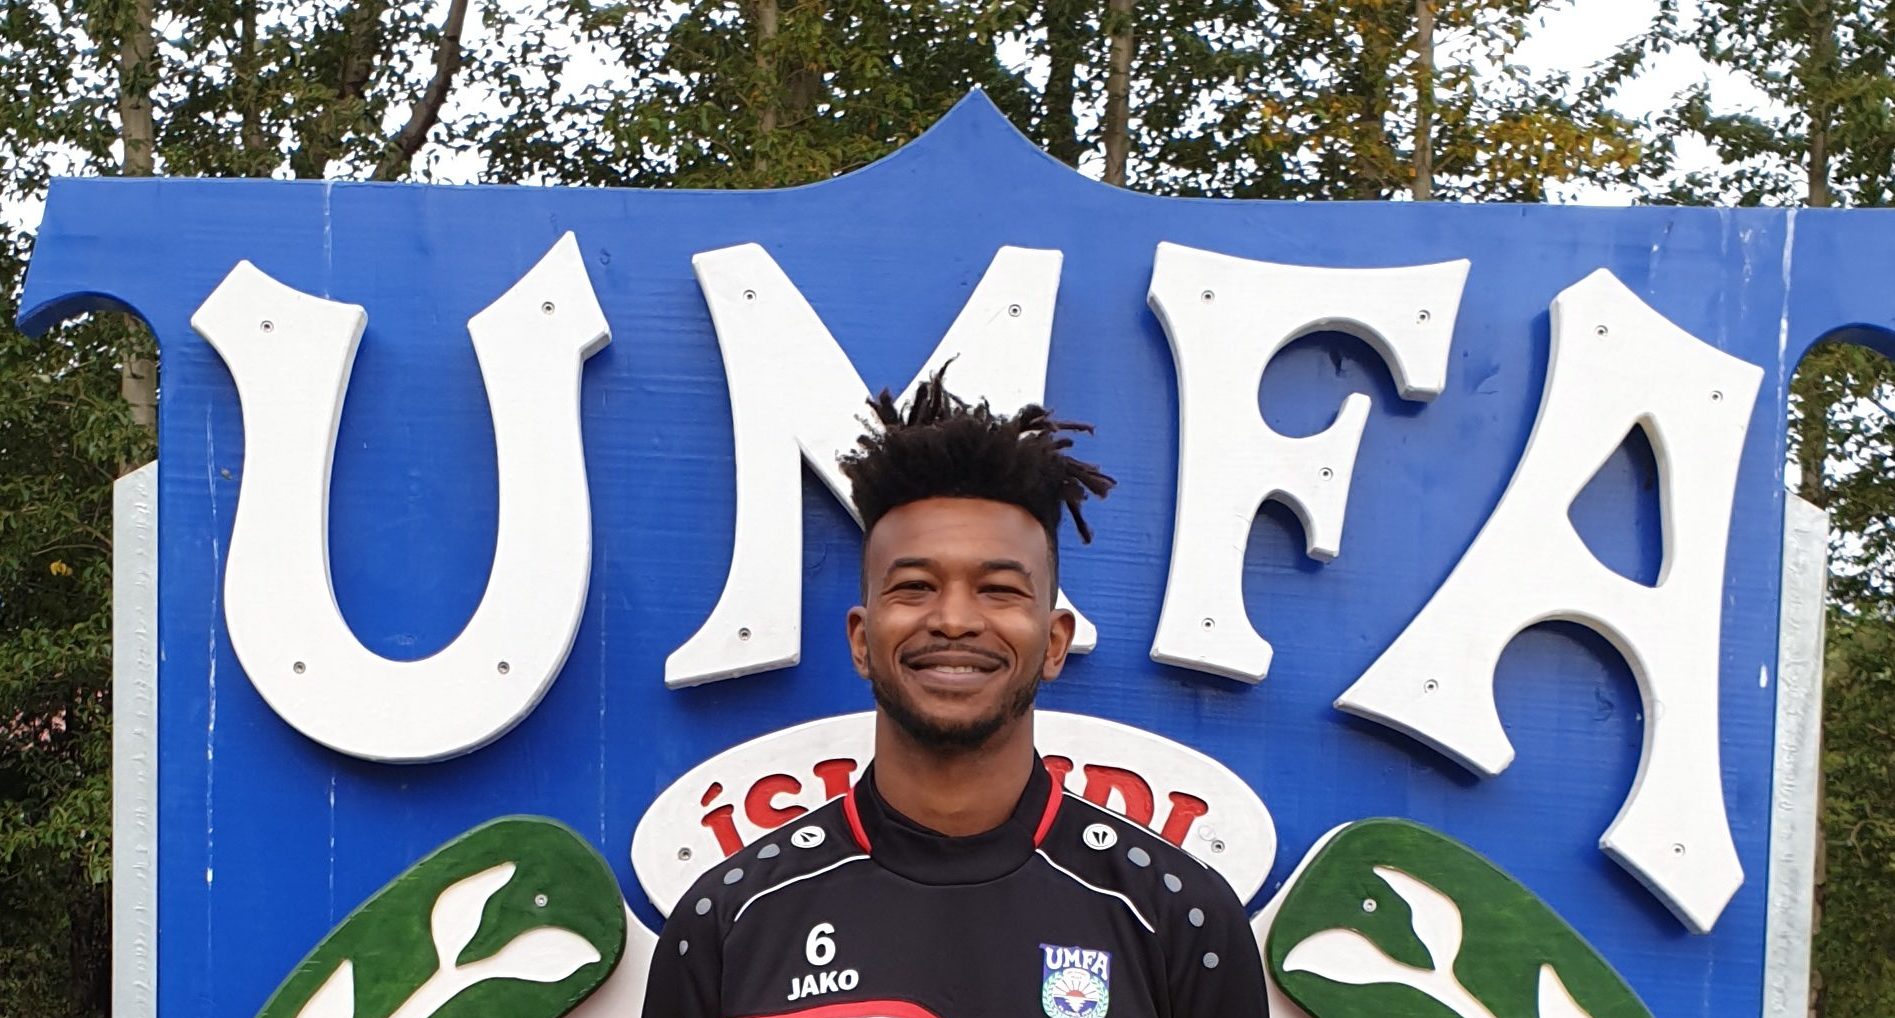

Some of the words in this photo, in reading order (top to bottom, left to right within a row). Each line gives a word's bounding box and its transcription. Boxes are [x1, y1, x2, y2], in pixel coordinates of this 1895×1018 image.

[190, 231, 1766, 933] UMFA
[805, 922, 836, 966] 6
[1045, 946, 1109, 981] UMFA
[787, 969, 859, 1001] JAKO
